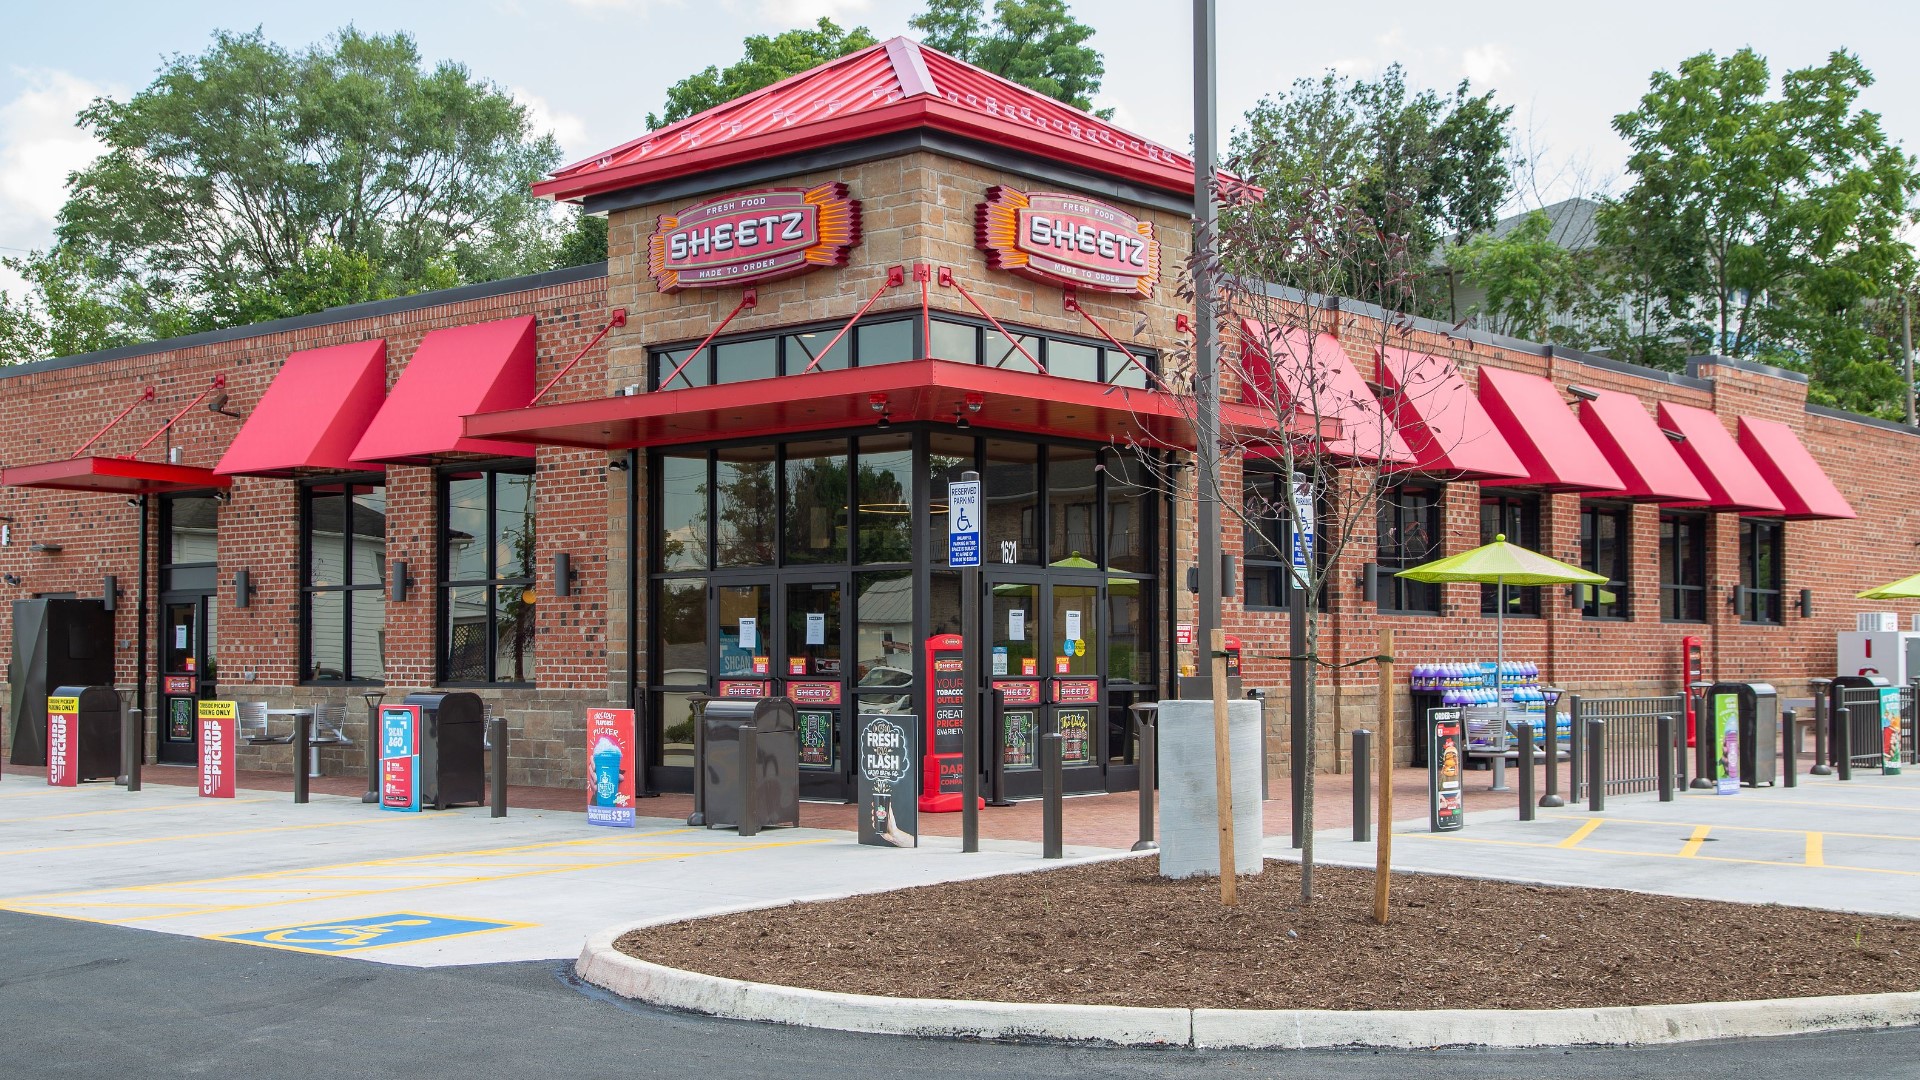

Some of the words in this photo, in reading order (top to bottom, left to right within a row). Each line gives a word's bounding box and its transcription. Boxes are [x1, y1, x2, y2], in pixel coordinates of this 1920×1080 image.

[706, 202, 735, 216] FRESH
[741, 198, 766, 208] FOOD
[1063, 202, 1090, 214] FRESH
[1094, 208, 1114, 221] FOOD
[670, 212, 803, 260] SHEETZ
[1030, 216, 1145, 266] SHEETZ
[700, 268, 722, 278] MADE
[726, 266, 738, 275] TO
[743, 259, 776, 272] ORDER
[1054, 264, 1076, 275] MADE
[1082, 269, 1092, 278] TO
[1096, 273, 1120, 283] ORDER
[952, 486, 976, 496] RESERVED
[954, 496, 975, 505] PARKING
[1001, 540, 1017, 564] 1621
[937, 678, 963, 688] YOUR
[937, 710, 963, 719] GREAT
[937, 720, 963, 728] PRICES
[58, 715, 67, 765] PICKUP
[593, 727, 618, 738] PUCKER
[212, 720, 222, 774] PICKUP
[867, 733, 899, 748] FRESH
[867, 755, 899, 770] FLASH
[940, 764, 963, 774] DAR
[588, 812, 611, 821] SMOOTHIES
